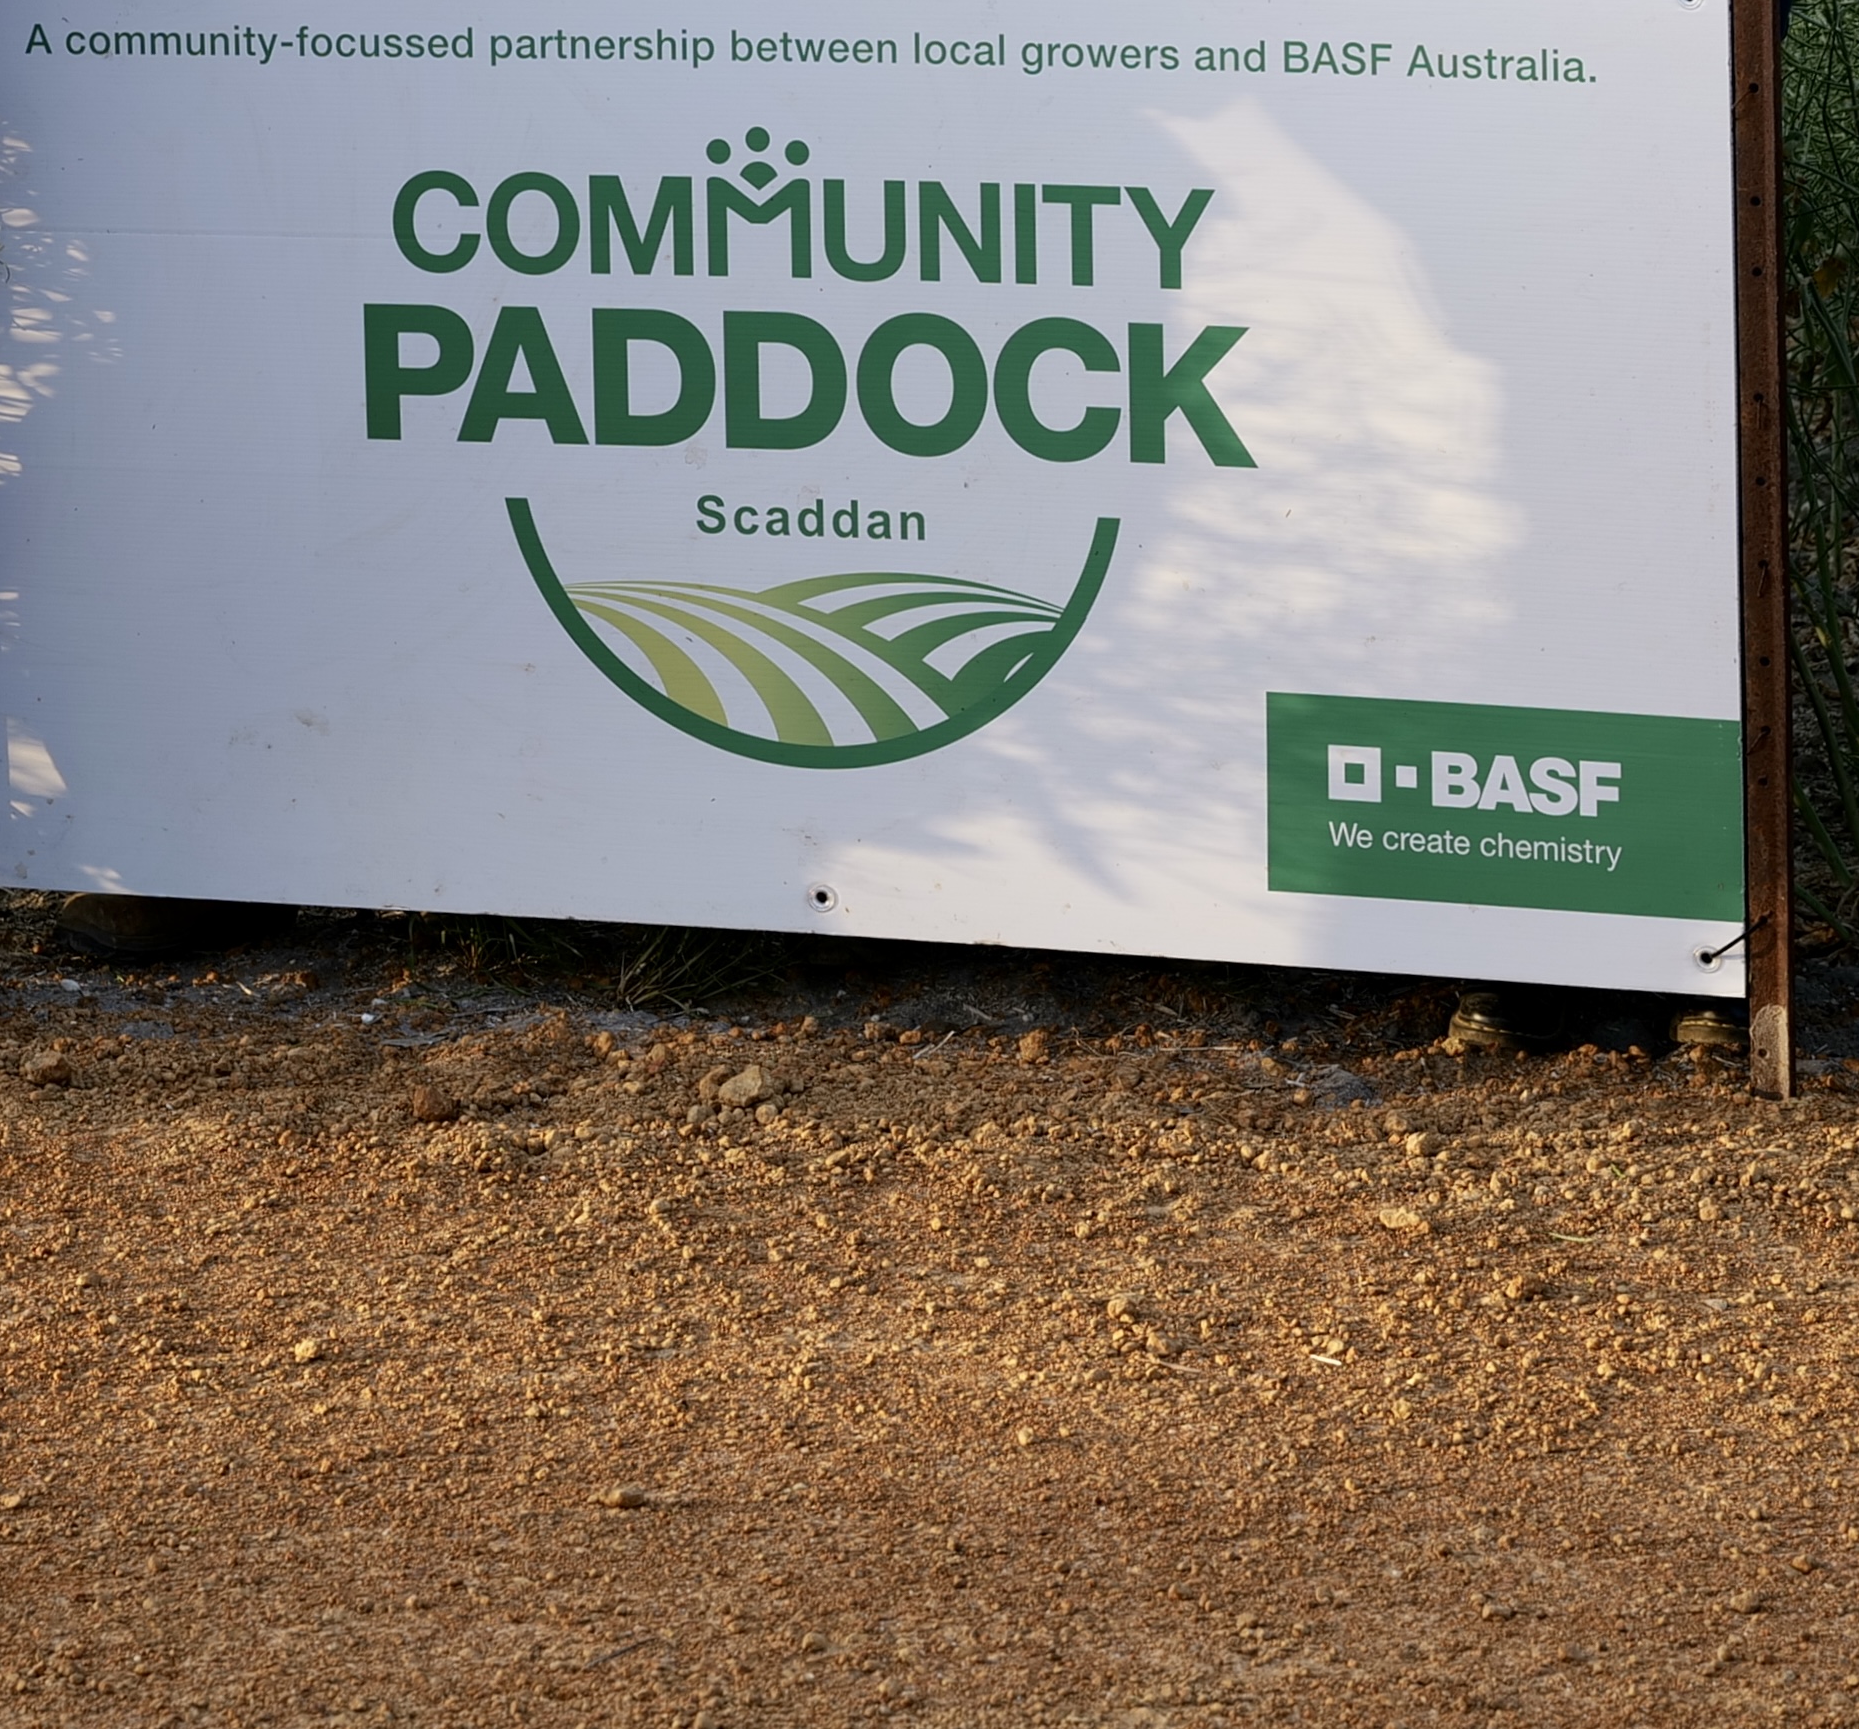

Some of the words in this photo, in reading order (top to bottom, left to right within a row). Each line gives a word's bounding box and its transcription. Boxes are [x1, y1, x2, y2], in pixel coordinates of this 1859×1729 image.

[25, 23, 54, 56] A
[64, 25, 474, 65] community-focussed
[490, 29, 715, 68] partnership
[731, 30, 897, 64] between
[914, 32, 1005, 67] local
[1021, 42, 1180, 76] growers
[1194, 41, 1266, 73] and
[1283, 40, 1392, 77] BASF
[1407, 44, 1597, 83] Australia.
[392, 169, 1215, 289] COMMUNITY
[363, 302, 1258, 469] PADDOCK
[695, 494, 927, 542] Scaddan
[1431, 750, 1622, 817] BASF
[1328, 821, 1373, 849] We
[1382, 830, 1471, 856] create
[1480, 832, 1622, 871] chemistry
